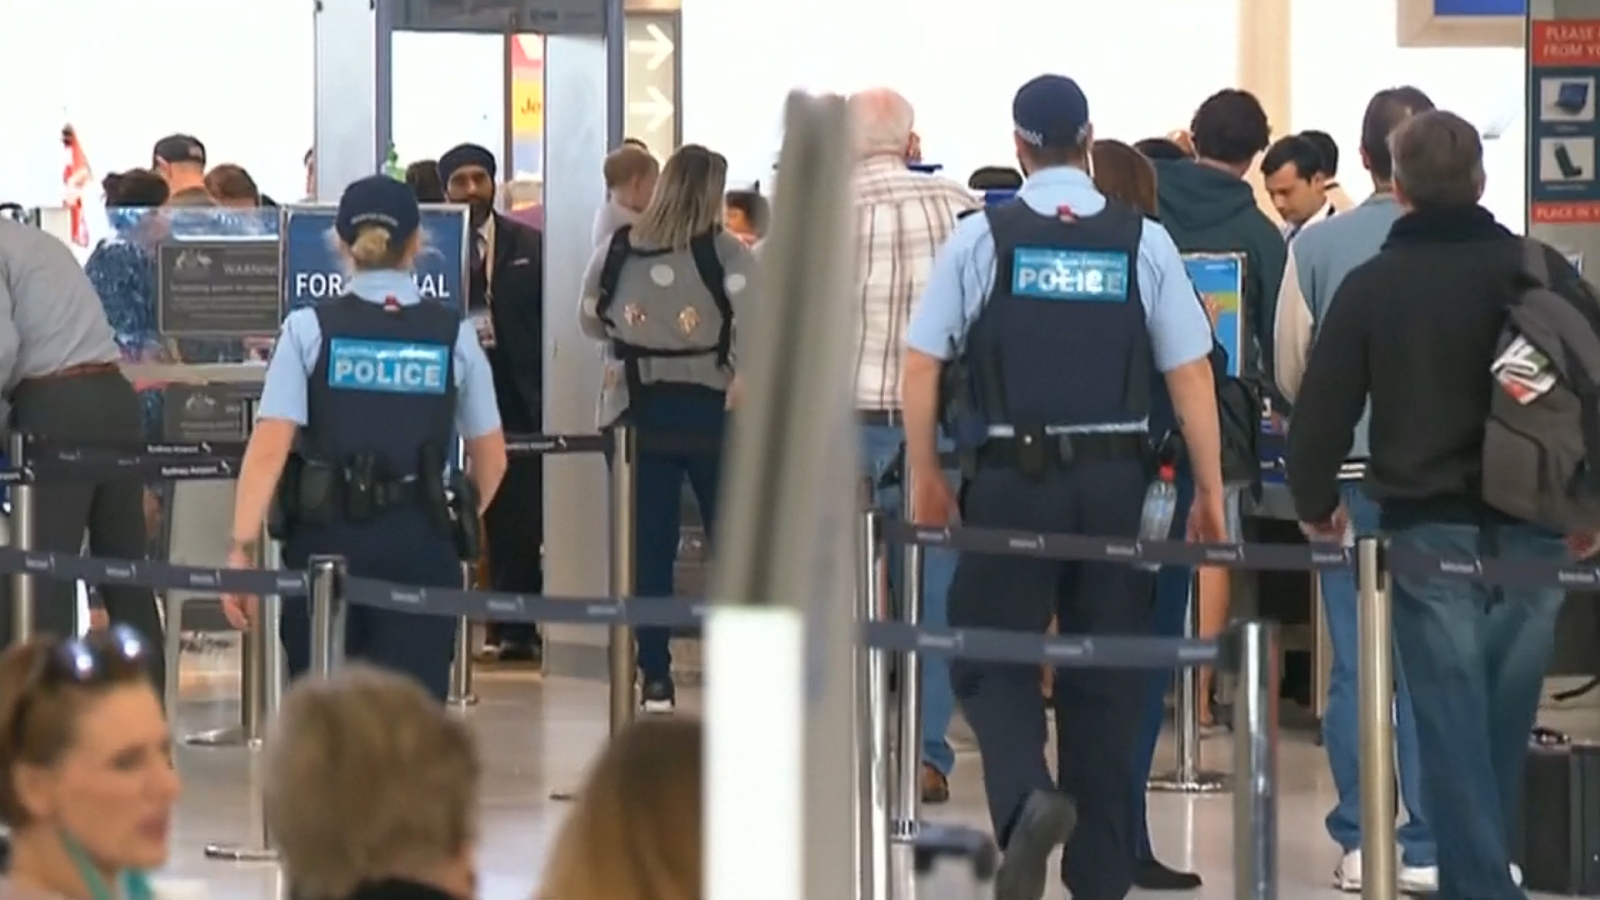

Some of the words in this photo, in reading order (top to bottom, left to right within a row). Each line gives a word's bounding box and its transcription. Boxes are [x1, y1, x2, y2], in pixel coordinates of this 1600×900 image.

[1545, 26, 1592, 39] PLEASE
[1543, 44, 1582, 58] FROM
[1537, 207, 1572, 219] PLACE
[295, 273, 342, 298] FOR
[1018, 266, 1124, 294] POLICE
[334, 358, 441, 386] POLICE
